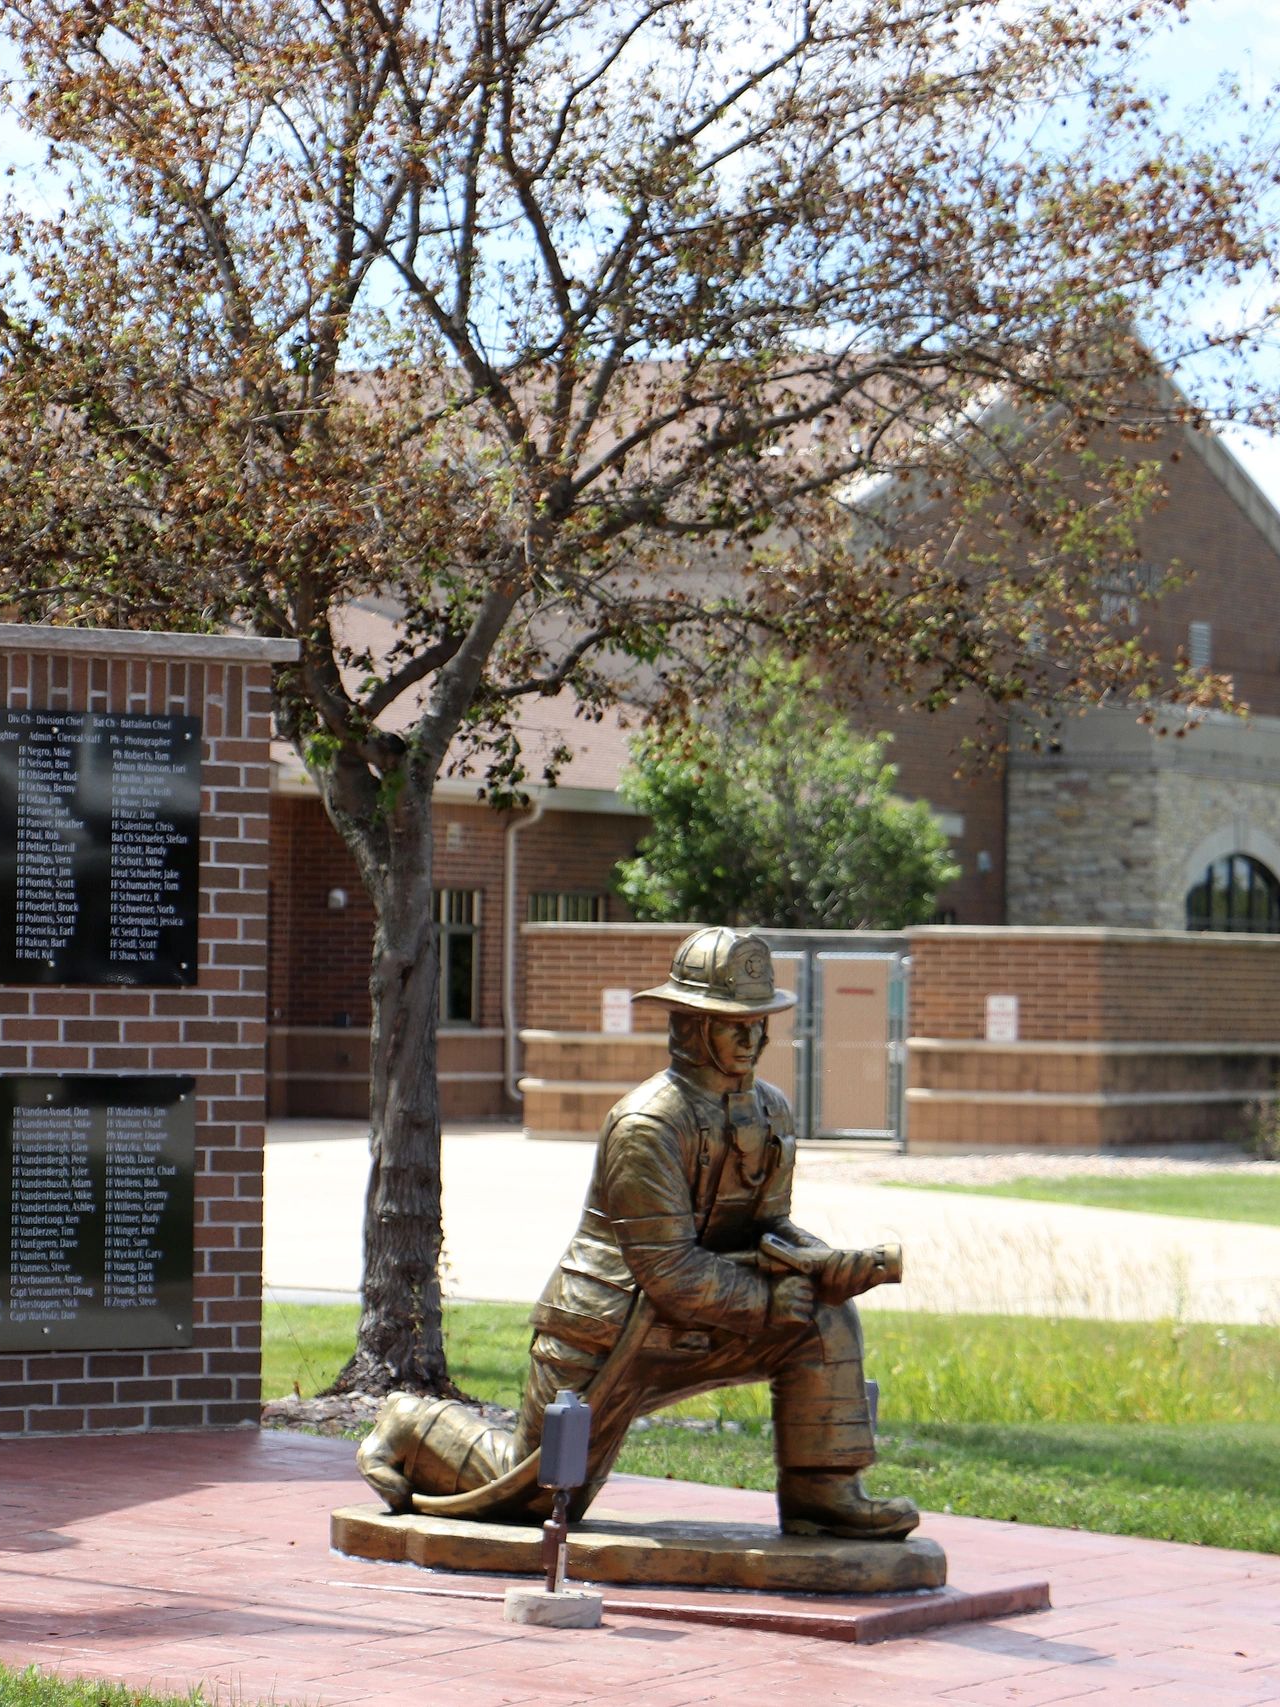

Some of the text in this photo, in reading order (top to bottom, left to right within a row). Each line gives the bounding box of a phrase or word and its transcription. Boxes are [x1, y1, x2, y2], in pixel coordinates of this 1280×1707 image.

[111, 844, 167, 855] FF Schott, Randy
[17, 877, 24, 886] FF
[56, 879, 74, 888] Scott
[17, 889, 24, 898] FF
[55, 891, 75, 900] Kevin
[111, 939, 157, 949] FF Seidl, Scott
[106, 1154, 155, 1164] FF Webb, Dave
